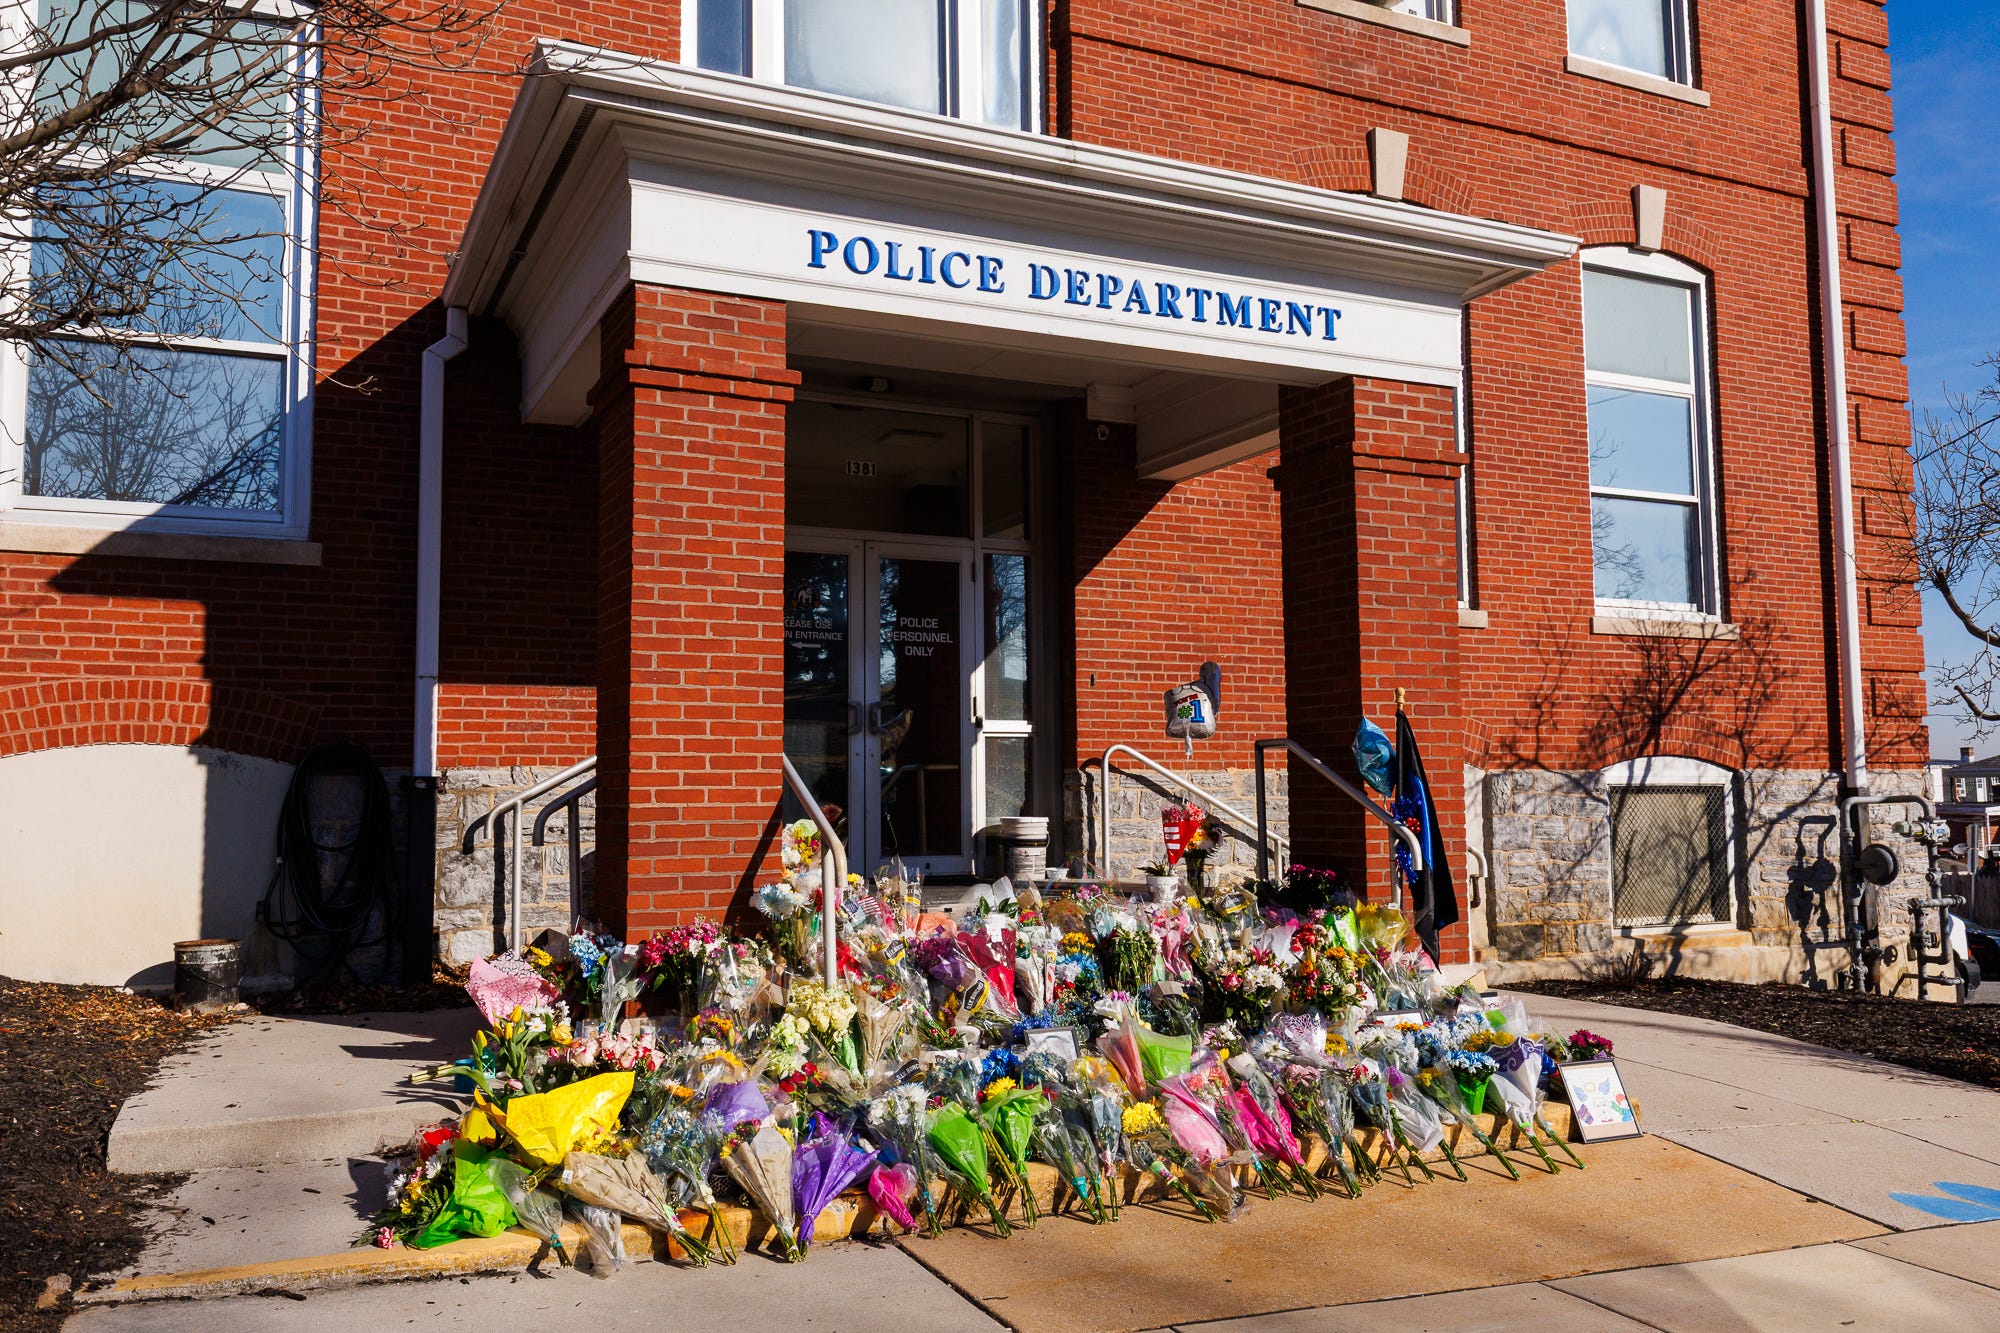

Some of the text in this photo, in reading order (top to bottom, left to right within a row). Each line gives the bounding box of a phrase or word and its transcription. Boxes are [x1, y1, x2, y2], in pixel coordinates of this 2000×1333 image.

[807, 229, 1342, 340] POLICE DEPARTMENT
[846, 461, 876, 476] 1381
[785, 619, 833, 629] LEASE USE
[900, 617, 939, 629] POLICE
[795, 630, 843, 641] ENTRANCE
[886, 631, 953, 643] PERSONNEL
[904, 645, 935, 657] ONLY
[1178, 700, 1205, 723] #1
